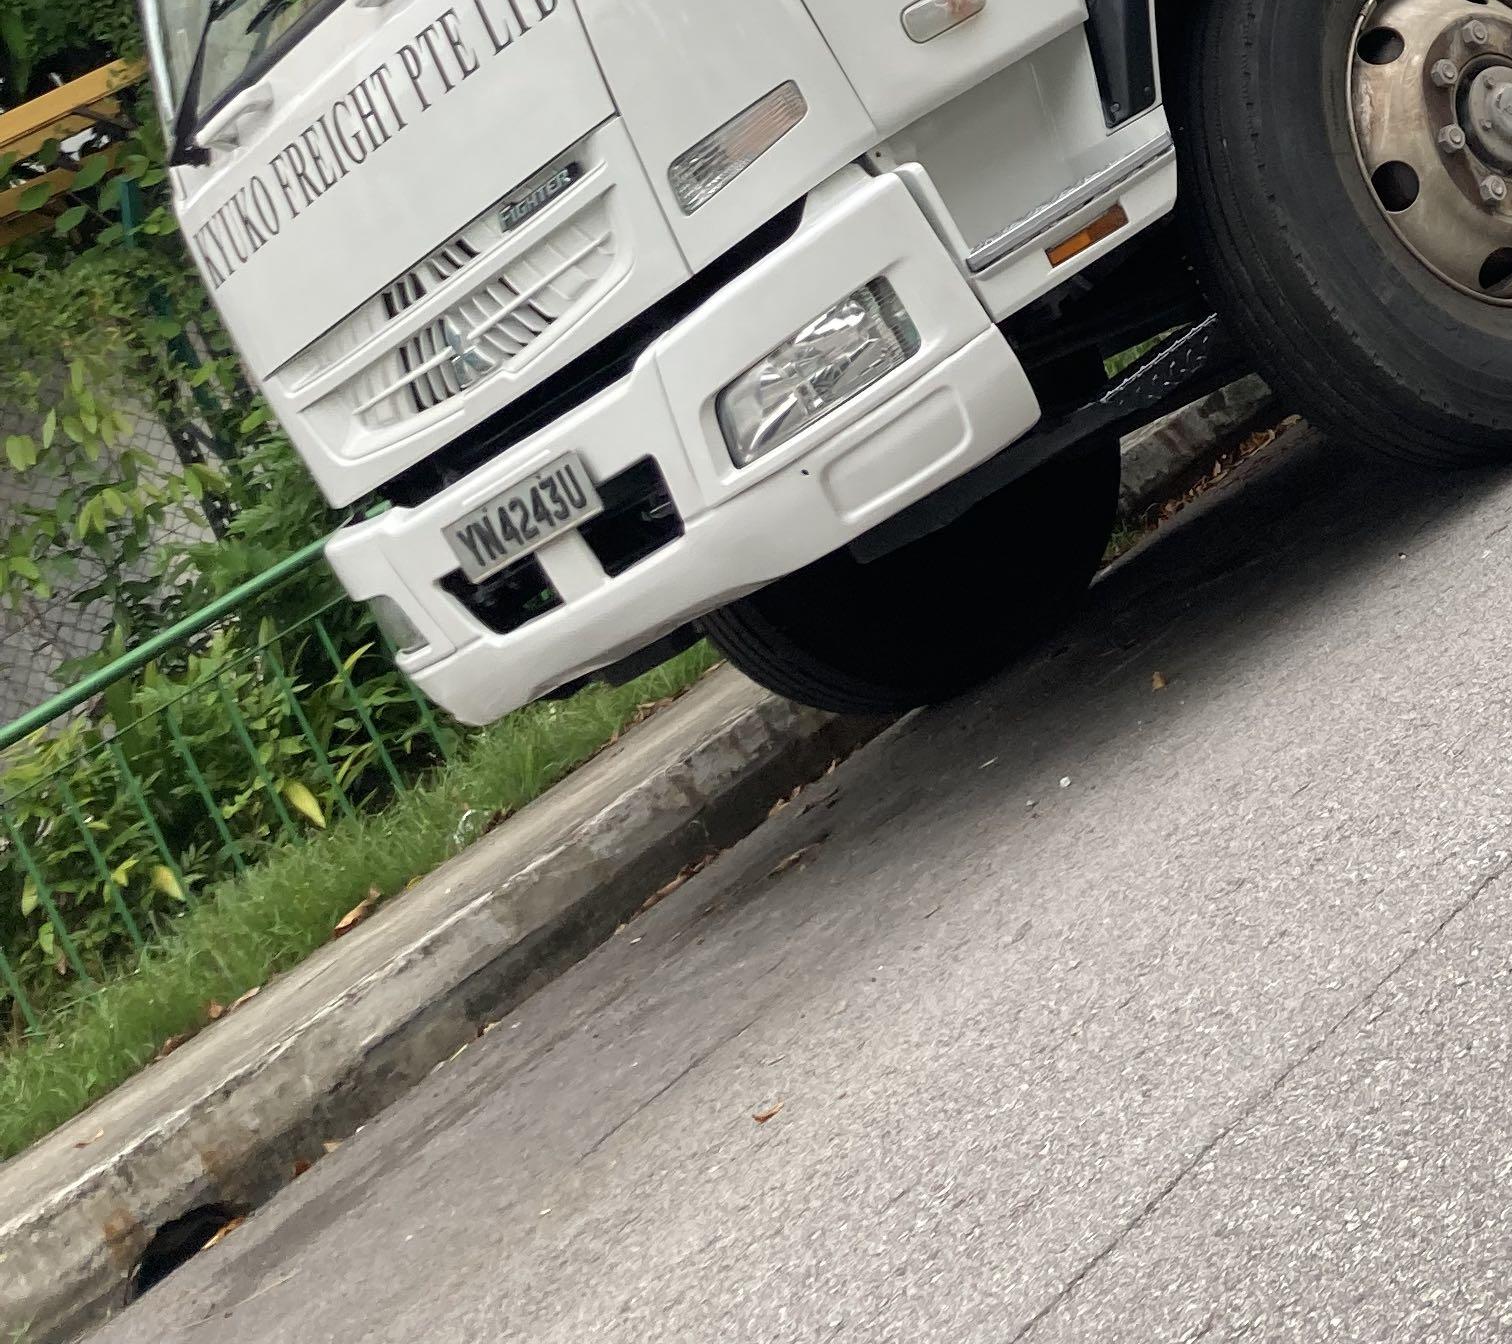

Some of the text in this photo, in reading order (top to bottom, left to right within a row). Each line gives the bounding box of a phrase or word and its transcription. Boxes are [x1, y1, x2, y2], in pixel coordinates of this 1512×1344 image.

[192, 175, 282, 290] KYUKO
[268, 62, 408, 220] FREIGHT
[396, 7, 481, 112] PTE
[499, 168, 573, 234] FIGHTER
[455, 464, 588, 567] YN4243U
